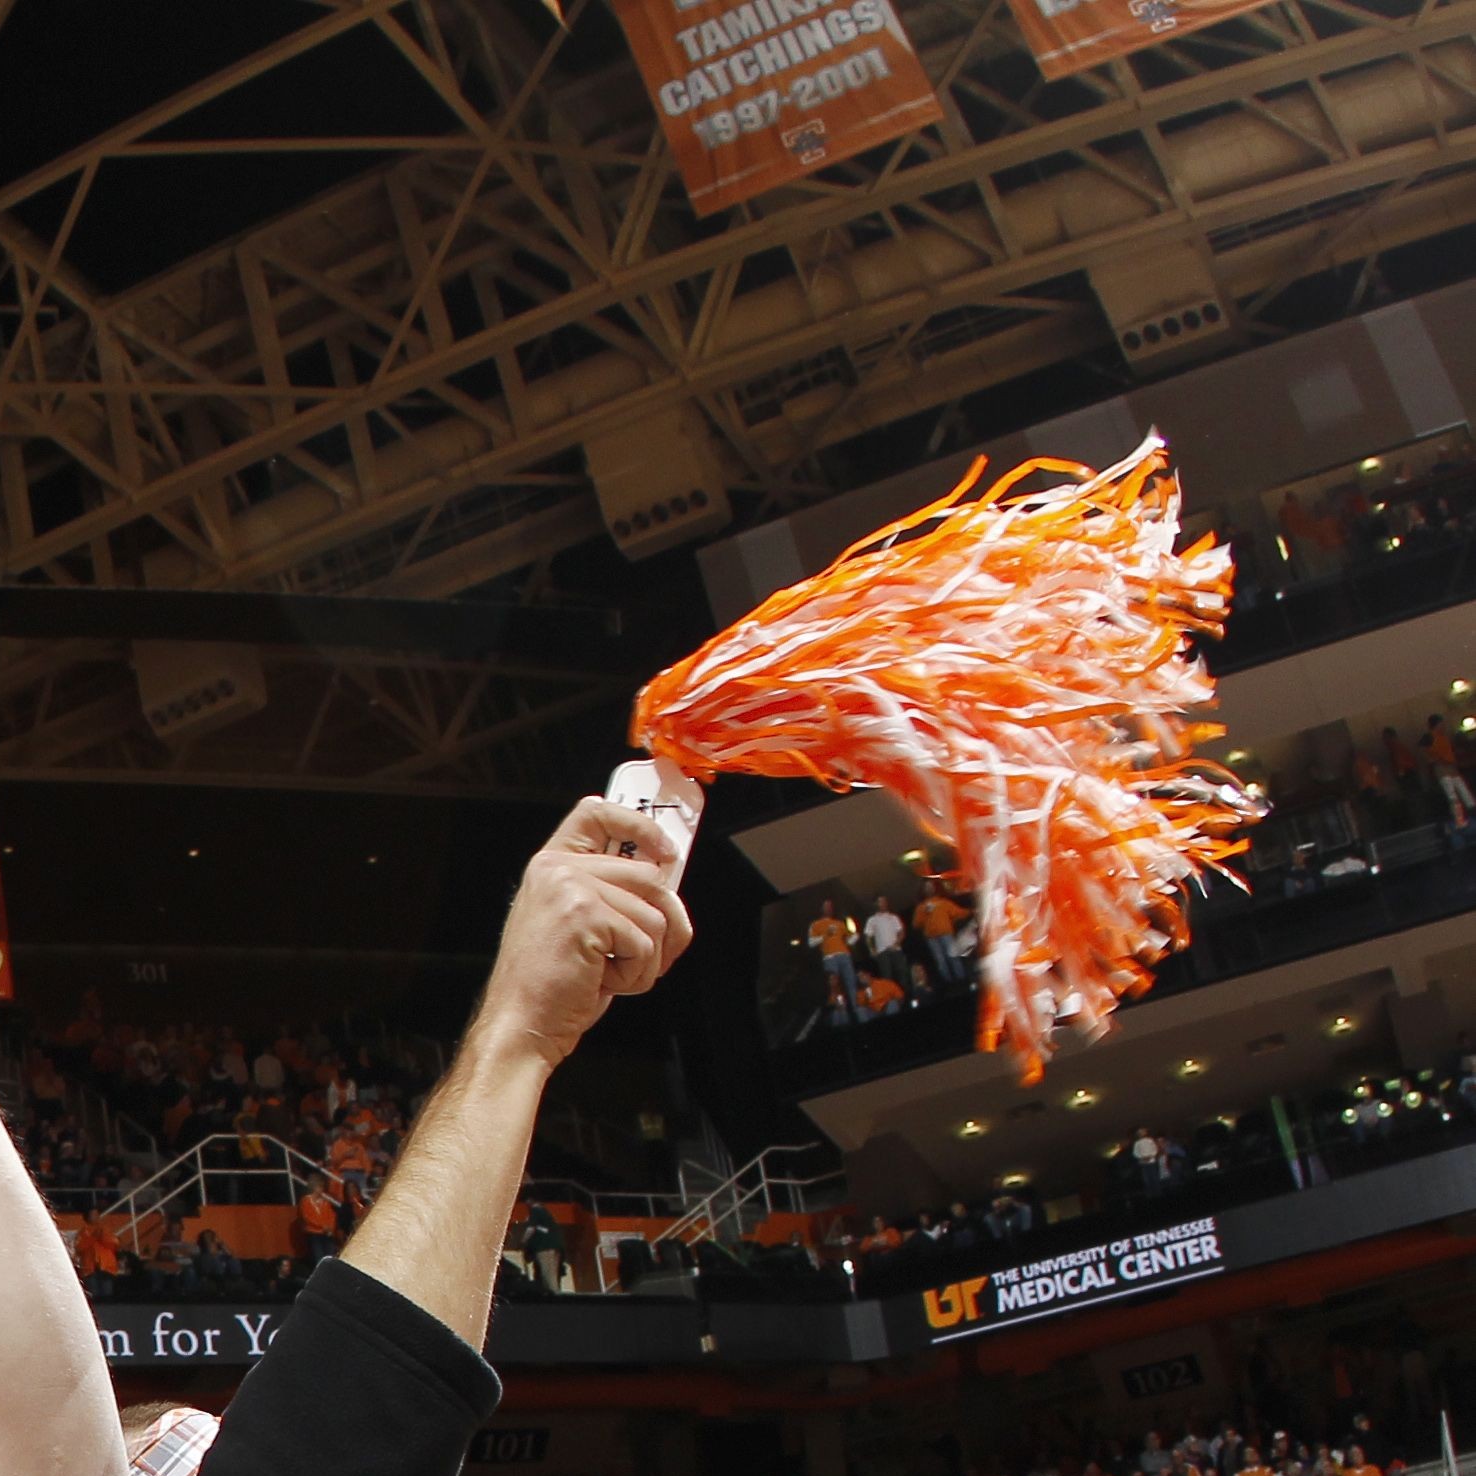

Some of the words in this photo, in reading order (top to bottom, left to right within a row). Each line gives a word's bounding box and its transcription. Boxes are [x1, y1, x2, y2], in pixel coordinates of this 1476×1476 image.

[658, 2, 887, 117] CATCHINGS
[692, 47, 893, 150] 1997-2001
[922, 1275, 988, 1329] UT
[996, 1261, 1116, 1314] MEDICAL
[1119, 1234, 1222, 1280] CENTER
[991, 1266, 1021, 1287] THE
[1022, 1244, 1108, 1279] UNIVERSITY
[1110, 1238, 1131, 1256] OF
[1133, 1216, 1217, 1249] TENNESSEE
[152, 1312, 221, 1357] for
[234, 1313, 280, 1357] Y
[479, 1430, 538, 1461] 101
